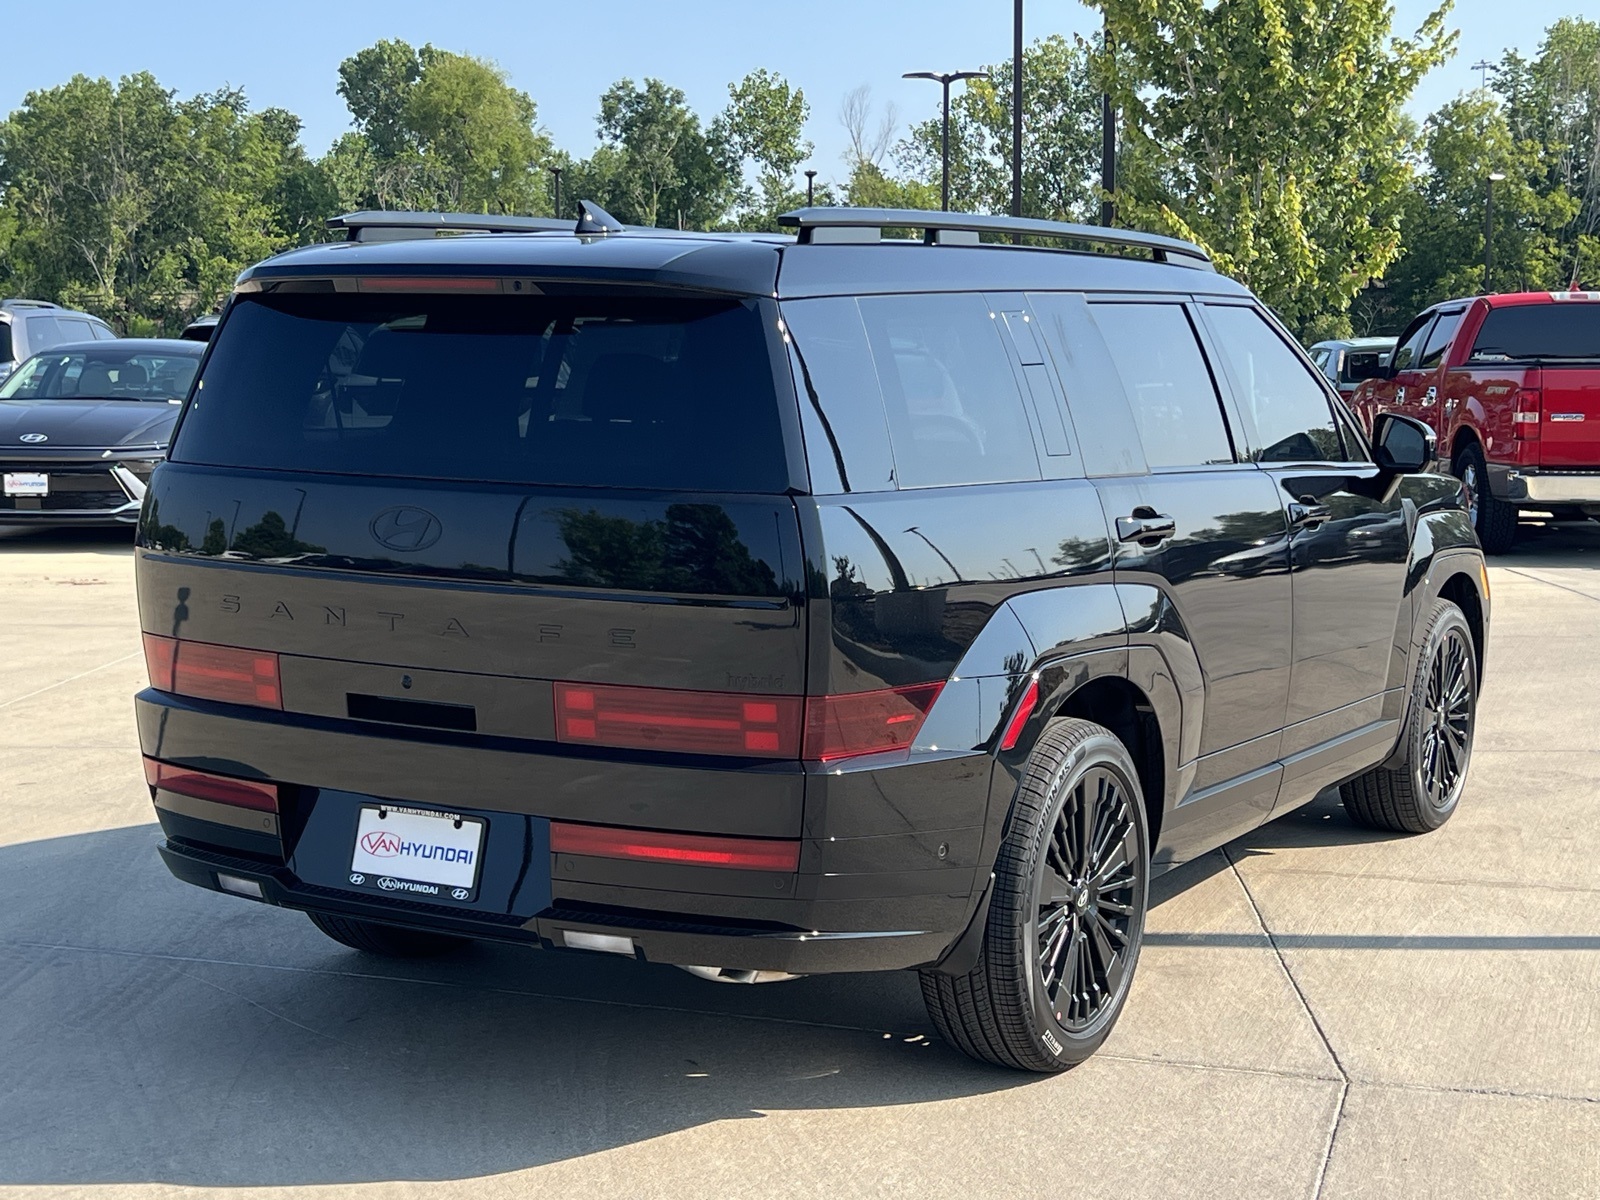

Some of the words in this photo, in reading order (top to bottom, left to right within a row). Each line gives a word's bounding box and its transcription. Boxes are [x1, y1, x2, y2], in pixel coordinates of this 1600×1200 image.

[219, 594, 470, 638] SANTA
[536, 623, 637, 649] FE
[725, 671, 786, 690] hybrid
[380, 804, 460, 821] WWW.VANHYUNDAI.COM
[400, 841, 474, 865] HYUNDAI
[396, 881, 439, 895] HYUNDAI
